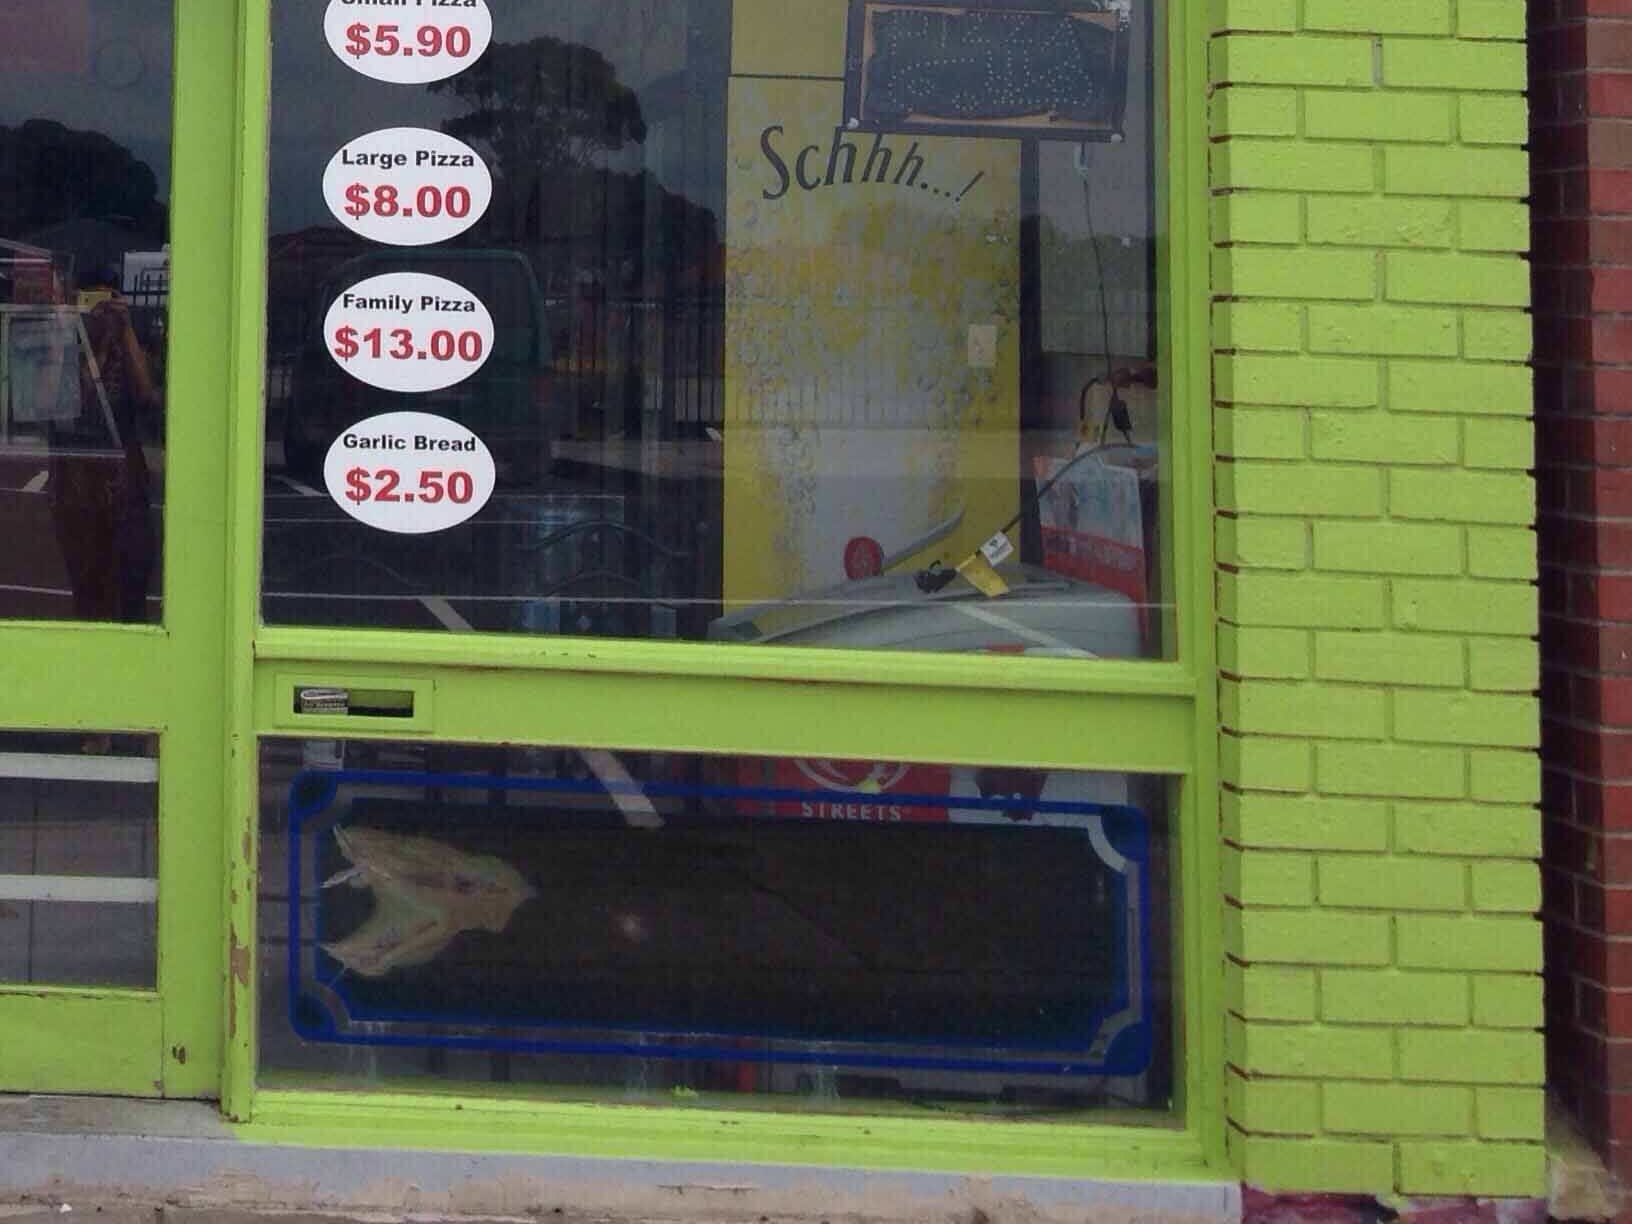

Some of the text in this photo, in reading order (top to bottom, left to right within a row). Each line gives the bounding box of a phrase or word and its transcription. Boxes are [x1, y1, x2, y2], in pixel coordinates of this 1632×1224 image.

[345, 22, 472, 61] $5.90
[342, 149, 475, 171] Large Pizza
[344, 183, 472, 221] $8.00
[342, 293, 477, 315] Family Pizza
[334, 326, 484, 362] $13.00
[342, 433, 477, 453] Garlic Bread
[345, 466, 475, 506] $2.50
[801, 800, 903, 823] STREETS
